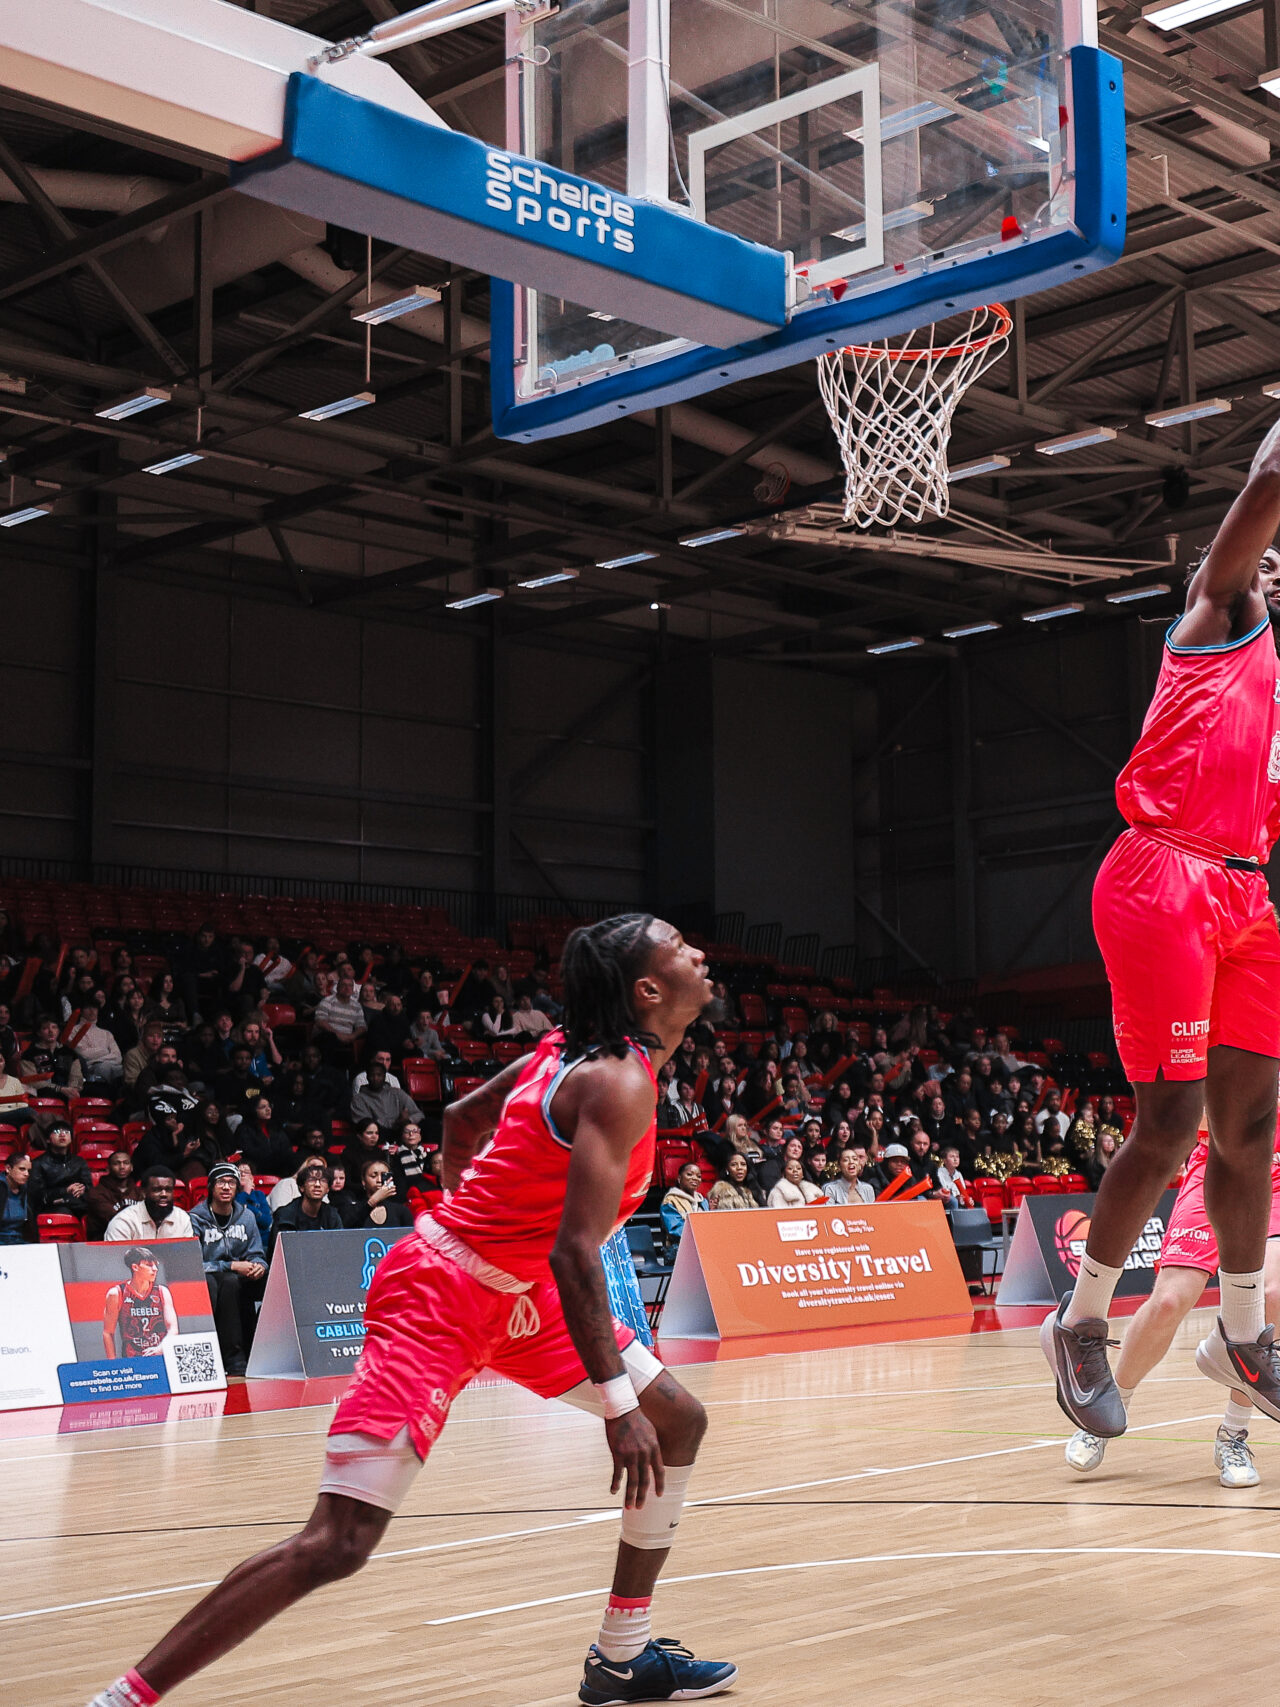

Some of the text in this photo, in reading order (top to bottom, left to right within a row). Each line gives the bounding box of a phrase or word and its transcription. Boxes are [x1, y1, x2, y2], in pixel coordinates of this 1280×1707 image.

[486, 151, 635, 227] Schelde
[486, 179, 635, 254] Sports
[1171, 1018, 1210, 1037] CLIFTO
[1170, 1227, 1210, 1242] CLIFTON
[794, 1243, 870, 1256] Have you registered with
[737, 1248, 932, 1287] Diversity Travel
[824, 1285, 856, 1294] University
[857, 1283, 875, 1291] travel
[875, 1282, 894, 1291] online
[894, 1281, 905, 1289] via
[798, 1292, 896, 1308] diversitytravel.co.uk/essex
[130, 1307, 159, 1316] REBELS
[326, 1302, 356, 1315] Your
[141, 1317, 150, 1332] 2
[316, 1323, 368, 1338] CABLIN
[0, 1346, 32, 1355] Elavon.
[331, 1347, 342, 1358] T:
[92, 1370, 111, 1378] Scan
[119, 1367, 134, 1375] visit
[69, 1373, 159, 1387] essexrebels.co.uk/Elavon
[112, 1384, 125, 1392] out
